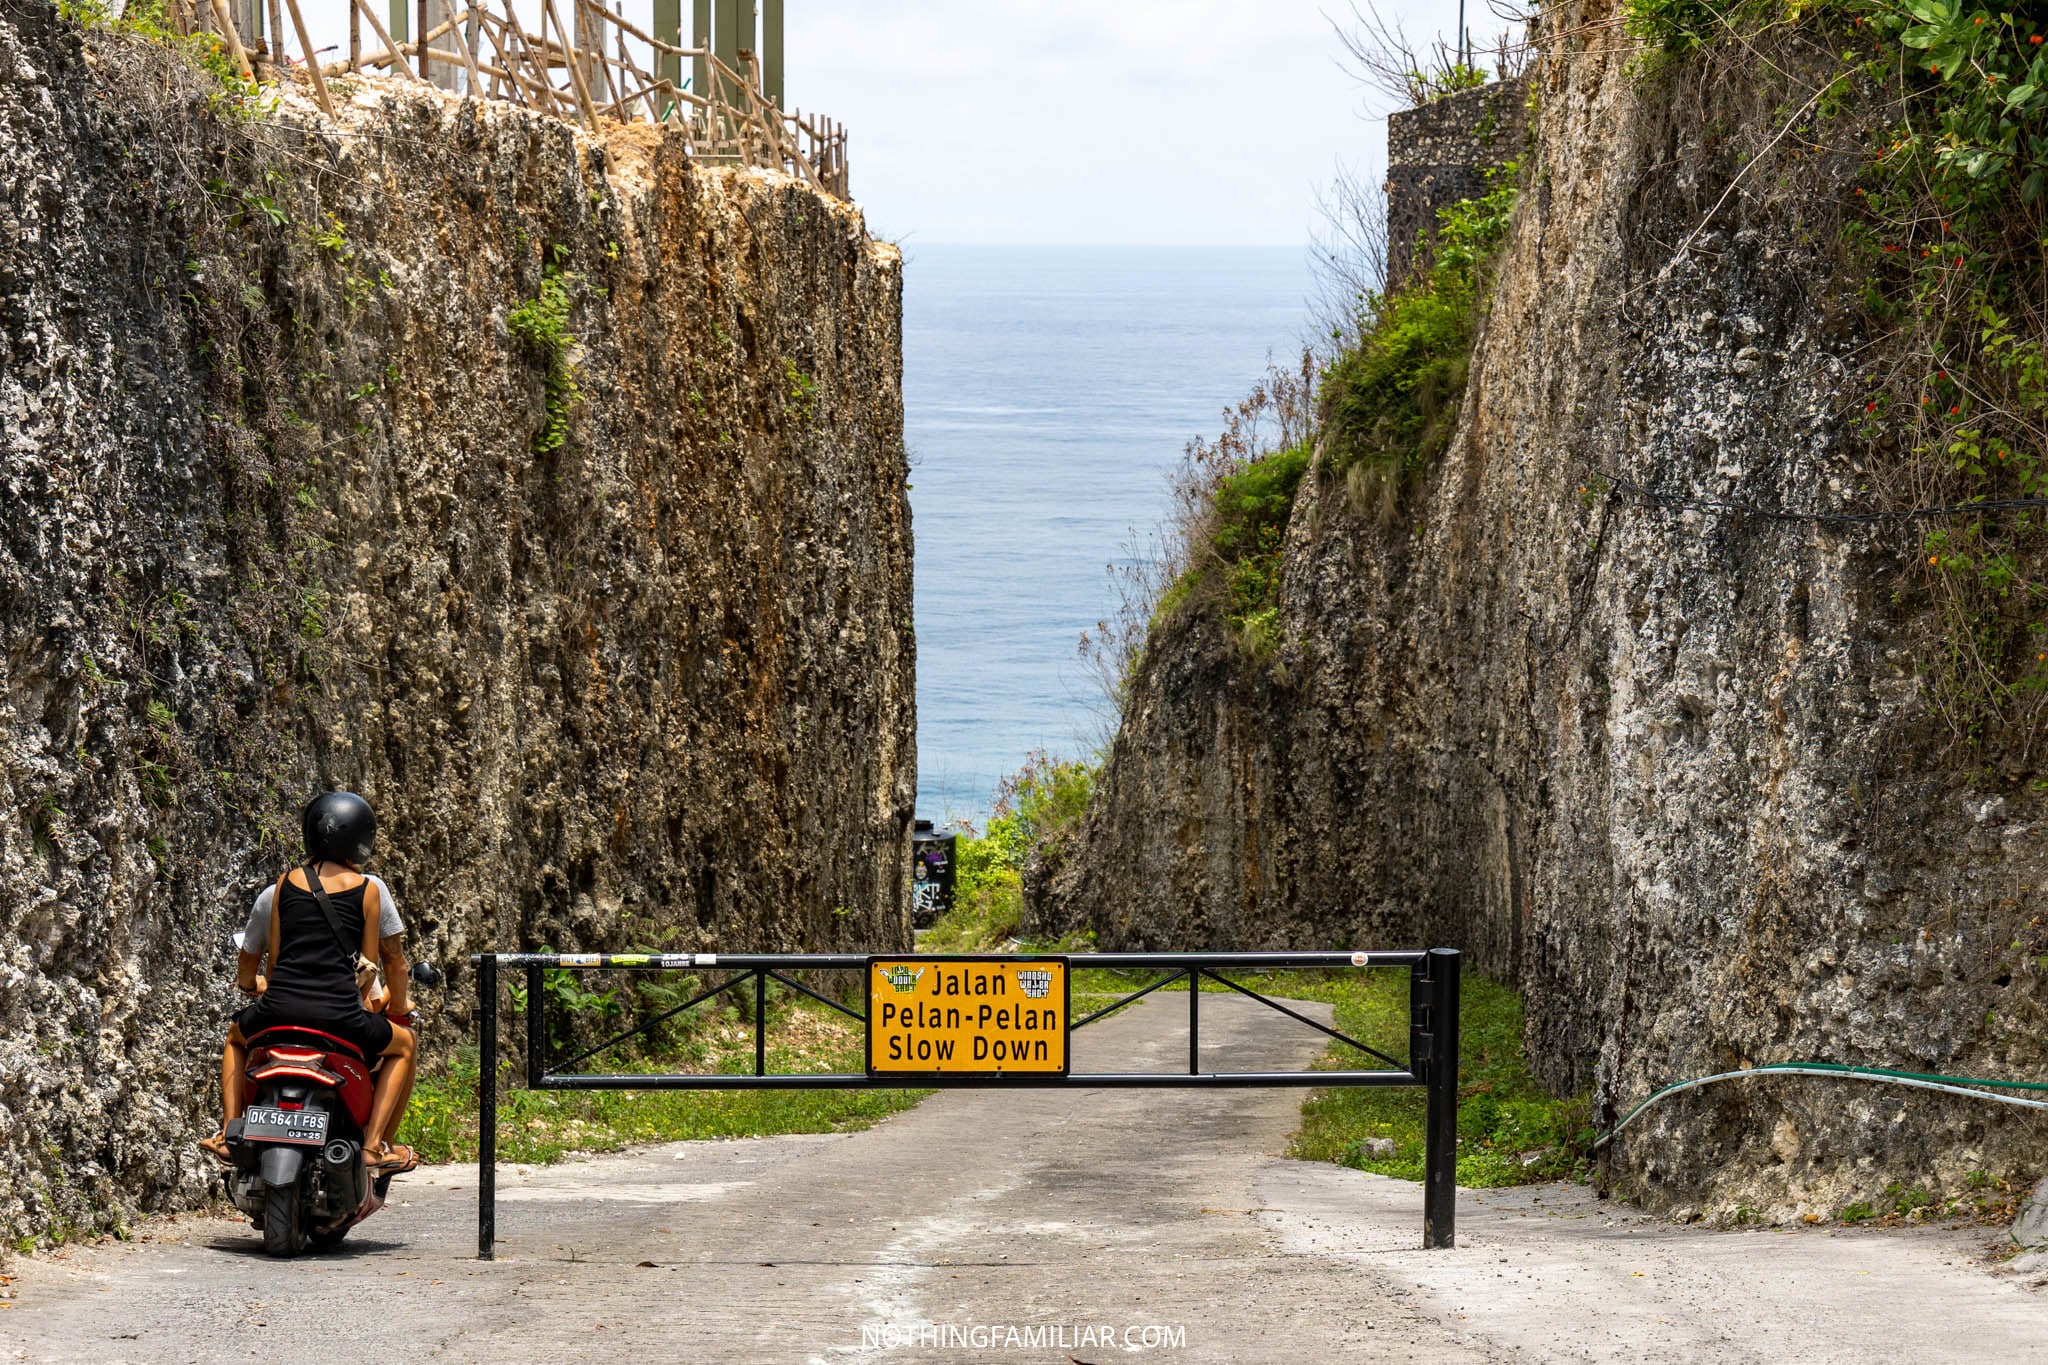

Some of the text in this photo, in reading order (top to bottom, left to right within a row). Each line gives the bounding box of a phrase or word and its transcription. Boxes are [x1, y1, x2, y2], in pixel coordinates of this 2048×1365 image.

[931, 968, 1006, 996] Jalan
[882, 1001, 1056, 1031] Pelan-Pelan
[889, 1034, 1048, 1061] Slow Down
[250, 1111, 325, 1129] DK 5641 FBS
